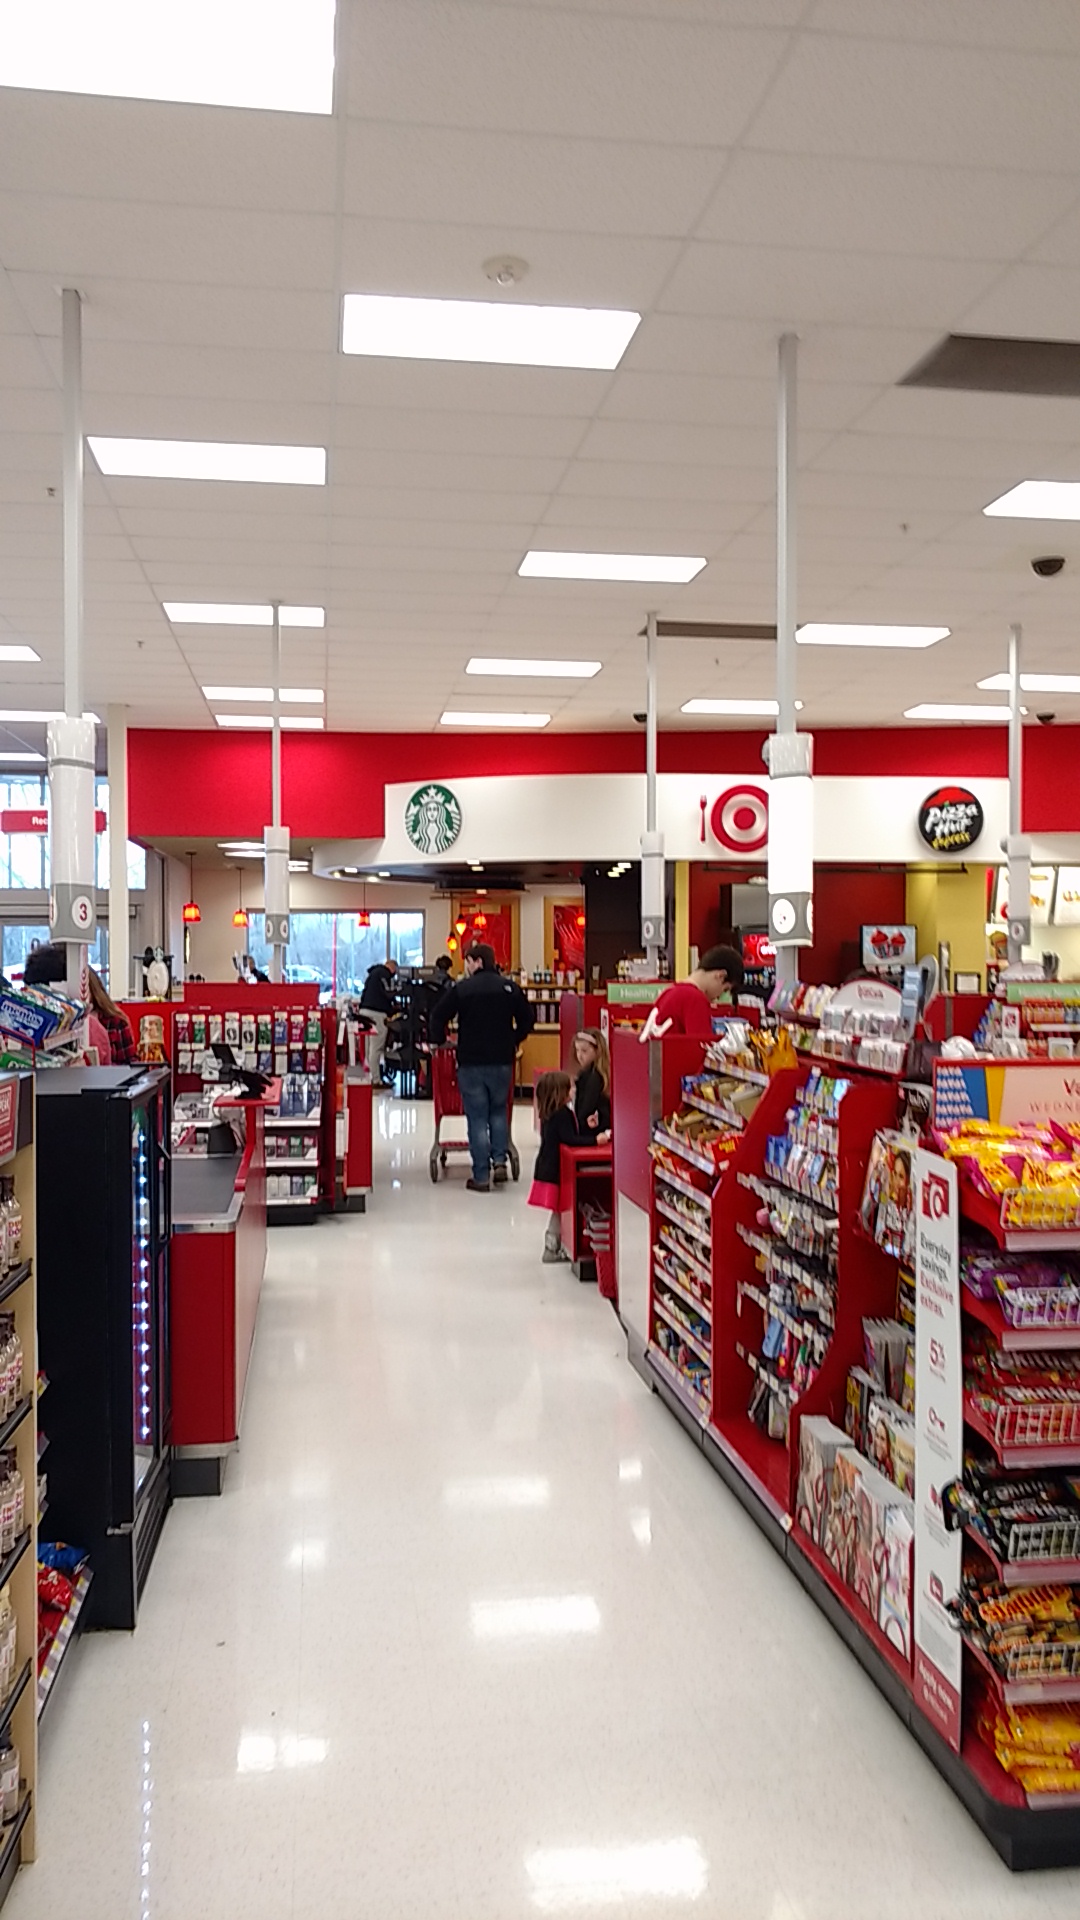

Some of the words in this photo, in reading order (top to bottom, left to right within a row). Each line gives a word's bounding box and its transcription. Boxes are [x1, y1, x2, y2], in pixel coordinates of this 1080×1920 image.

[79, 903, 88, 922] 3
[2, 1002, 42, 1026] mentos
[920, 1231, 952, 1268] Everyday
[920, 1270, 954, 1306] Exclusive
